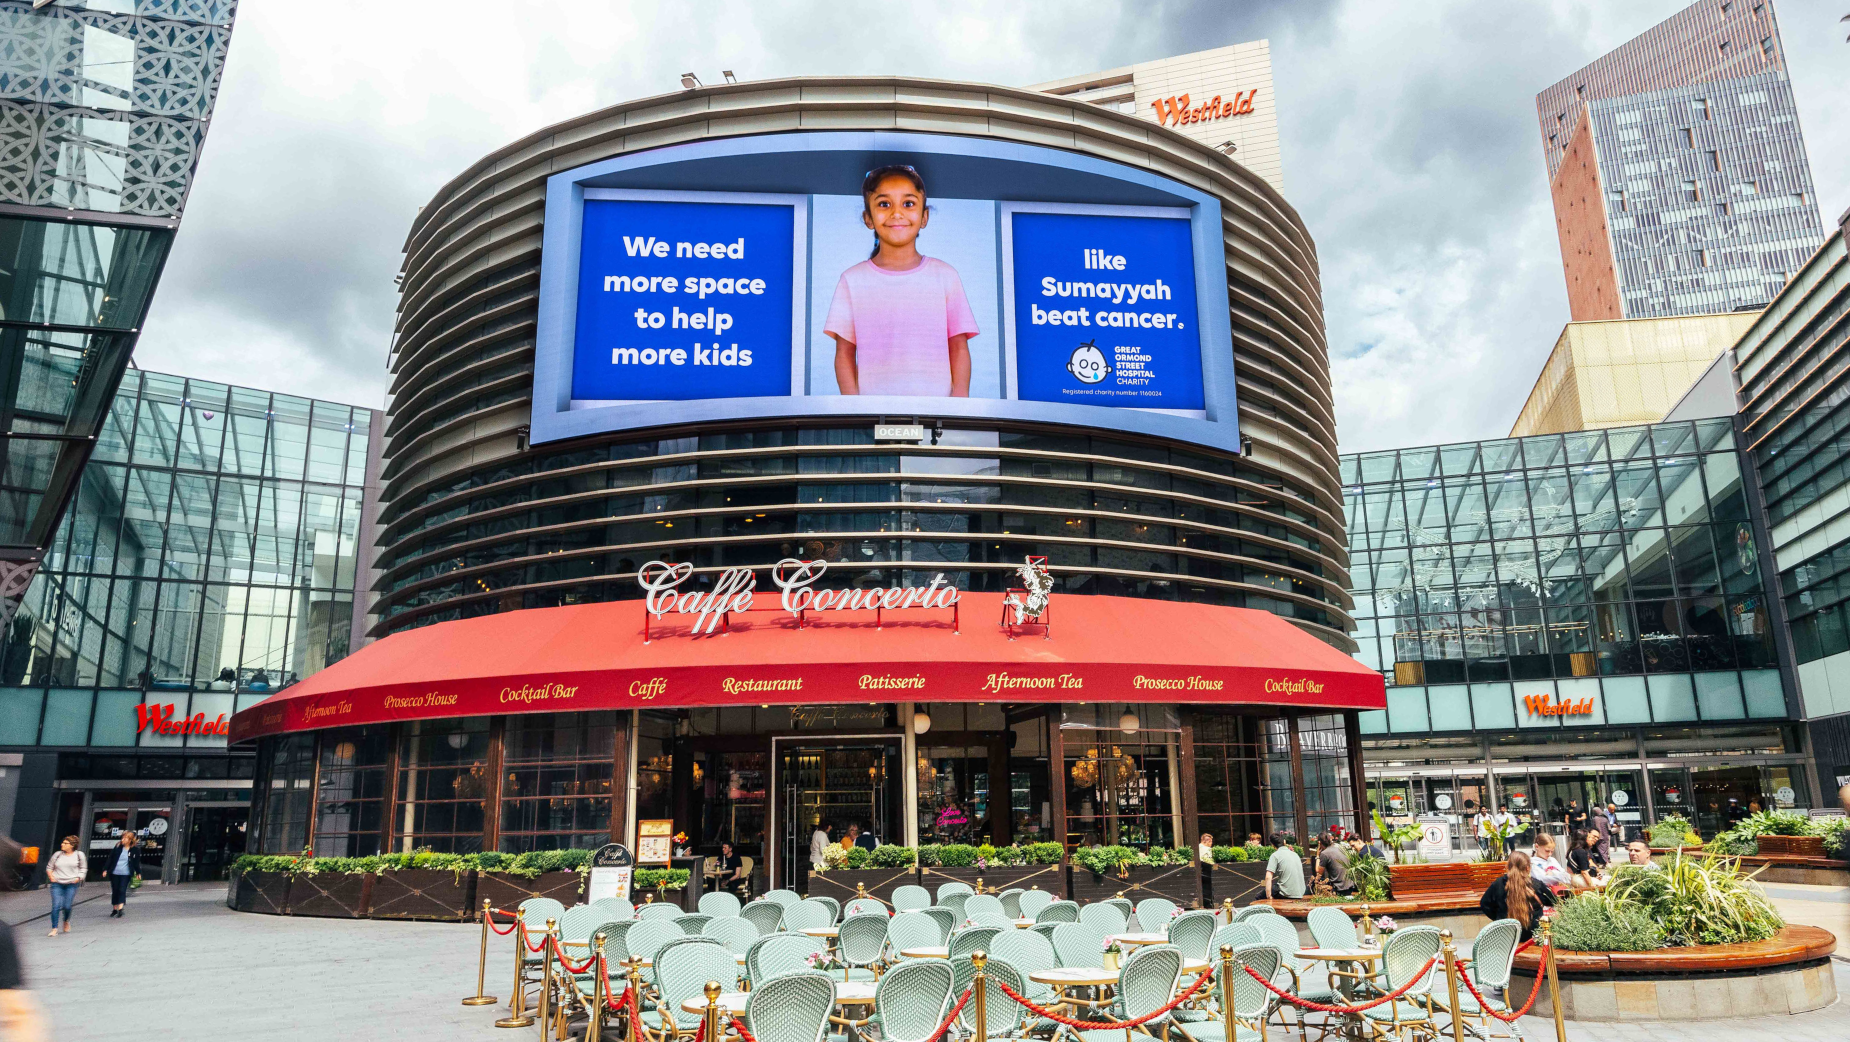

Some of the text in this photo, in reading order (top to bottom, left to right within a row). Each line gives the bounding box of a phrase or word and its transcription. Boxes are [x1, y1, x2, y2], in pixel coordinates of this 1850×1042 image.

[1152, 89, 1257, 127] Westfield
[623, 236, 744, 259] We need
[1084, 248, 1127, 270] like
[604, 275, 766, 299] more space
[1041, 276, 1171, 304] Sumayyah
[634, 307, 733, 335] to help
[1031, 304, 1184, 330] beat cancer.
[611, 342, 752, 366] more kids
[1115, 346, 1141, 354] GREAT
[1115, 354, 1152, 362] ORMOND
[1116, 369, 1155, 378] HOSPITAL
[1117, 378, 1150, 386] CHARITY
[1062, 388, 1094, 396] Registered
[1094, 389, 1115, 397] charity
[879, 426, 920, 438] OCEAN
[638, 558, 961, 634] Caffé Concerto
[628, 677, 668, 700] Caffé
[722, 677, 803, 695] Restaurant
[859, 673, 926, 690] Patisserie
[982, 672, 1083, 693] Afternoon Tea
[1133, 675, 1223, 690] Prosecco House
[1265, 678, 1324, 695] Cocktail Bar
[384, 692, 458, 709] Prosecco House
[499, 682, 578, 704] Cocktail Bar
[302, 704, 337, 723] Afternoon
[337, 700, 353, 714] Tea
[1523, 694, 1595, 716] Westfield
